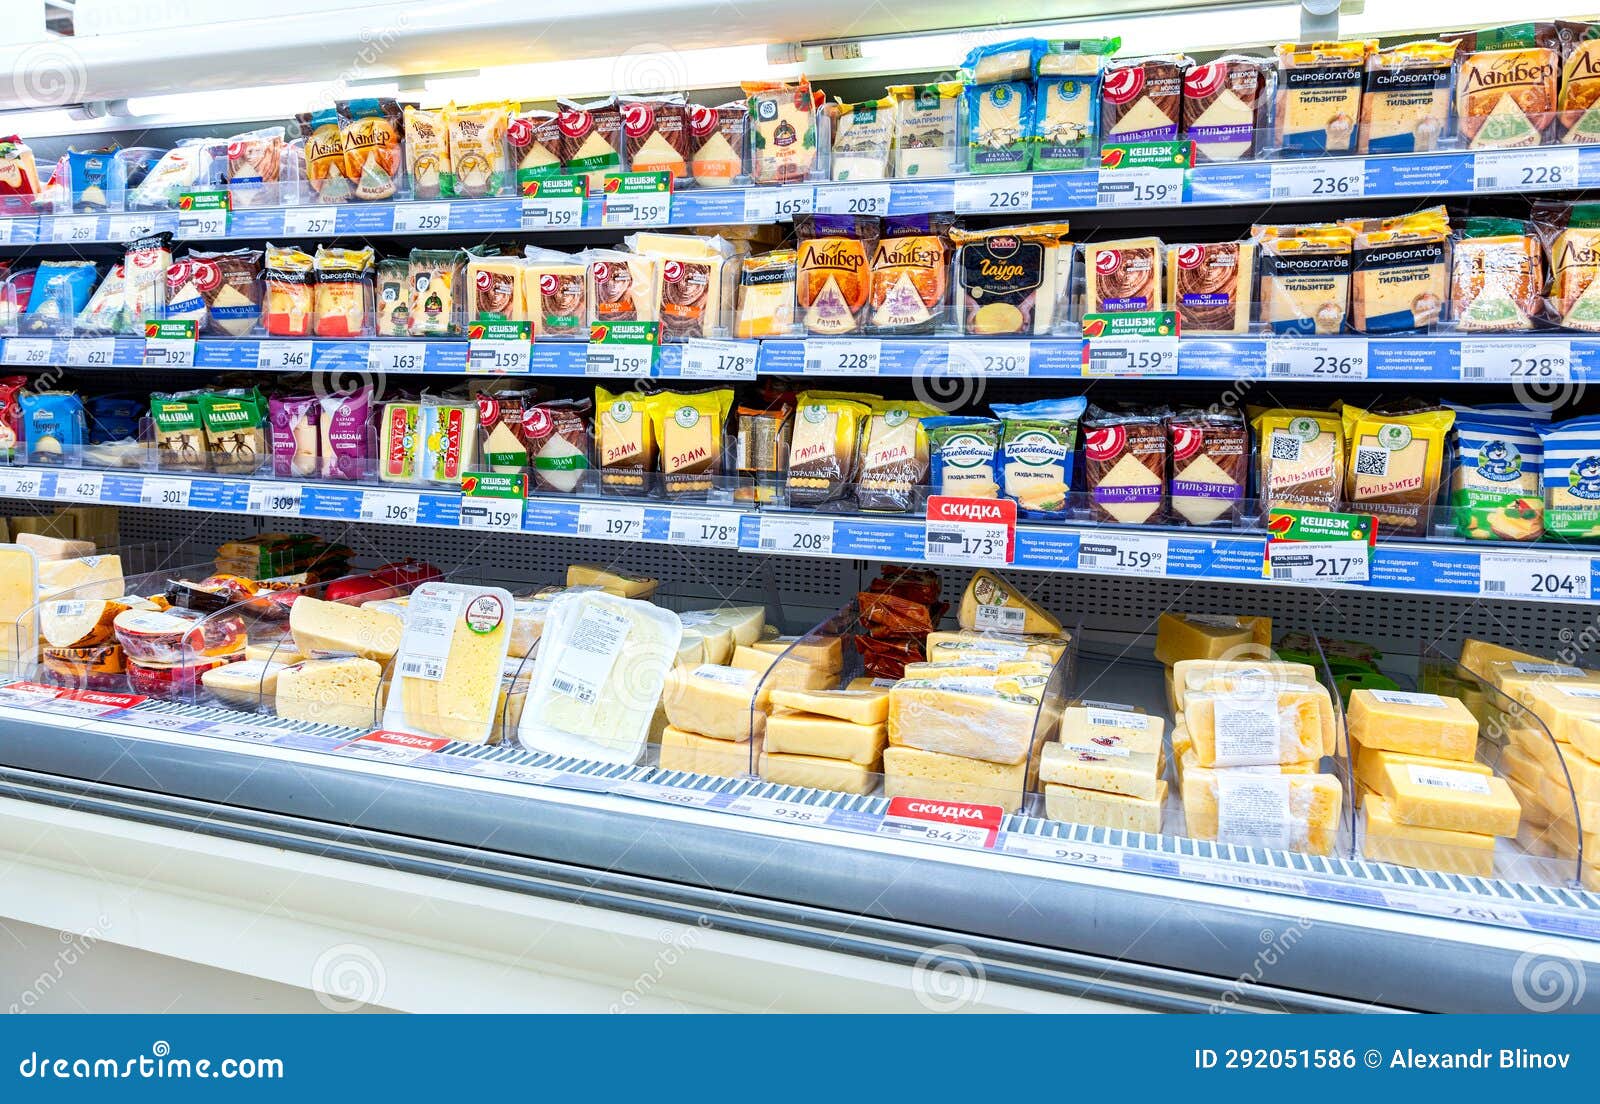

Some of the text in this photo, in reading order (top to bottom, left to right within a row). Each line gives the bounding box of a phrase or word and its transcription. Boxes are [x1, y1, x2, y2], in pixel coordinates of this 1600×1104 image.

[1290, 71, 1361, 83] СЫРОБОГАТОВ
[1377, 72, 1447, 84] СЫРОБОГАТОВ
[1466, 64, 1553, 90] Ламбер
[1299, 95, 1347, 104] ТИЛЬЗИТЕР
[1385, 98, 1433, 106] ТИЛЬЗИТЕР
[1116, 127, 1171, 143] ТИЛЬЗИТЕР
[1197, 126, 1253, 137] ТИЛЬЗИТЕР
[1129, 146, 1172, 156] КЕШБЭК
[624, 176, 656, 185] КЕШБЭК
[1521, 166, 1562, 184] 228
[542, 180, 573, 188] КЕШБЭК
[1312, 176, 1360, 193] 236 99
[989, 192, 1020, 208] 226
[1134, 186, 1166, 201] 159
[775, 200, 801, 215] 165
[848, 198, 877, 213] 203
[547, 211, 571, 225] 159
[633, 207, 658, 221] 159
[307, 220, 327, 232] 257
[418, 216, 440, 229] 259
[802, 246, 864, 271] Ламбер
[872, 243, 941, 270] Ламбер
[1366, 248, 1442, 263] СЫРОБОГАТОВ
[980, 259, 1025, 281] Гауда
[1275, 257, 1348, 269] СЫРОБОГАТОВ
[1378, 273, 1430, 284] ТИЛЬЗИТЕР
[1285, 283, 1335, 291] ТИЛЬЗИТЕР
[1104, 302, 1147, 310] ТИЛЬЗИТЕР
[816, 317, 841, 328] ГАУДА
[887, 315, 916, 325] ГАУДА
[1112, 317, 1156, 327] КЕШБЭК
[488, 325, 519, 333] КЕШБЭК
[612, 325, 645, 333] КЕШБЭК
[88, 352, 106, 363] 621
[166, 352, 184, 364] 192
[282, 353, 303, 365] 346
[392, 355, 414, 368] 163
[494, 353, 519, 367] 159
[717, 355, 753, 372] 178 99
[838, 353, 868, 368] 228
[984, 356, 1016, 371] 230
[1127, 351, 1173, 368] 159 99
[614, 358, 639, 372] 159
[1313, 356, 1352, 374] 236
[1510, 358, 1565, 376] 228 99
[158, 412, 194, 424] MAASDAM
[208, 411, 249, 424] MAASDAM
[607, 442, 637, 458] ЭДАМ
[671, 447, 707, 465] ЭДАМ
[794, 444, 826, 460] ГАУДА
[1007, 442, 1065, 459] Белебеевский
[481, 478, 512, 486] КЕШБЭК
[1176, 481, 1235, 494] ТИЛЬЗИТЕР
[1358, 476, 1421, 495] ТИЛЬЗИТЕР
[77, 483, 95, 496] 423
[162, 490, 181, 503] 301
[1103, 486, 1160, 497] ТИЛЬЗИТЕР
[385, 506, 408, 520] 196
[941, 502, 1002, 519] СКИДКА
[487, 512, 511, 526] 159
[1300, 515, 1350, 529] КЕШБЭК
[606, 519, 640, 534] 197 99
[700, 525, 728, 541] 178
[792, 533, 822, 549] 208
[962, 539, 1004, 555] 173 90
[1116, 551, 1162, 567] 159 99
[1314, 557, 1363, 576] 217 99
[1531, 573, 1586, 592] 204 99
[775, 808, 812, 821] 938
[907, 801, 984, 820] СКИДКА
[925, 828, 967, 845] 847
[1055, 848, 1099, 864] 993
